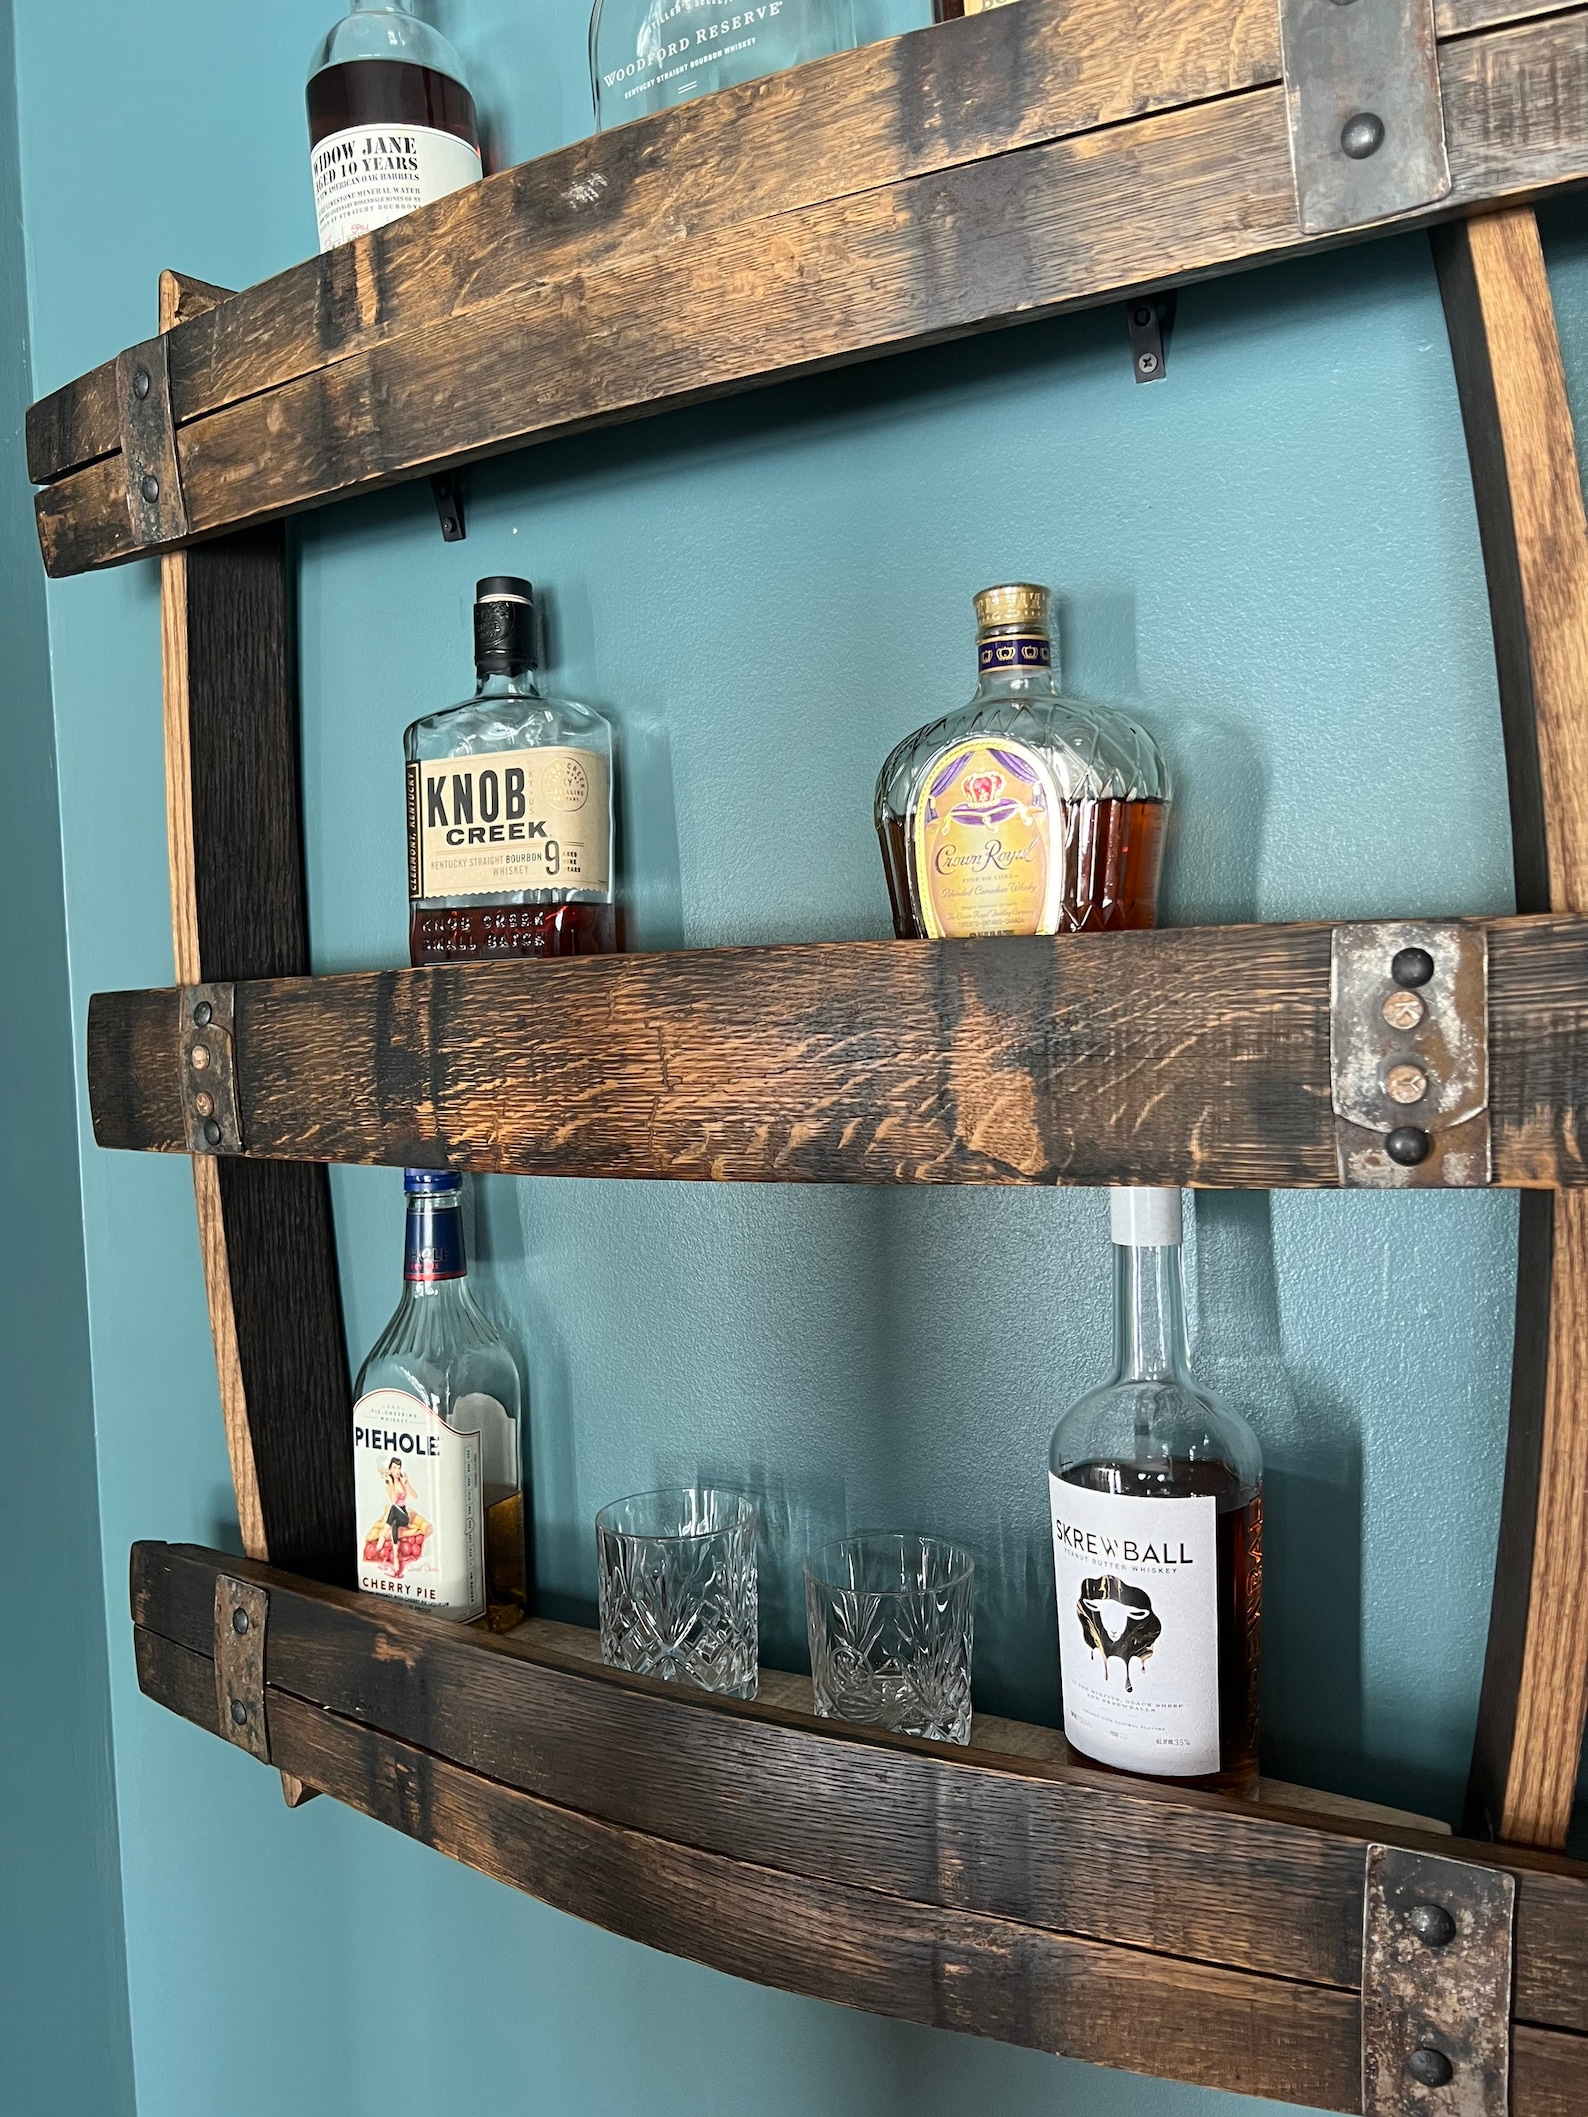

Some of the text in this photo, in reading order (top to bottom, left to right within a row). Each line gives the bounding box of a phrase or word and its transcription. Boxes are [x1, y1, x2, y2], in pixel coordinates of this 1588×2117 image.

[604, 38, 690, 88] WOODFORD
[624, 37, 756, 100] KENTUCKY STRAIGHT BOURBON WHISKEY
[362, 137, 417, 156] JANE
[341, 161, 358, 178] 10
[362, 157, 418, 172] YEARS
[329, 176, 360, 193] AMERICAN
[361, 174, 378, 182] OAK
[381, 173, 419, 181] BARRELS
[358, 188, 392, 199] MINERAL
[340, 206, 374, 219] STRAIGHT
[408, 773, 416, 828] KENTUCKY
[428, 768, 526, 827] KNOB
[446, 821, 547, 846] CREEK
[431, 853, 542, 870] KENTUCKY STRAIGHT BOURBON
[545, 841, 559, 875] 9
[935, 839, 1036, 875] Crown Royal
[493, 865, 529, 876] WHISKEY
[941, 886, 974, 898] Blended
[356, 1427, 440, 1456] PIEHOLE
[1057, 1519, 1193, 1564] SKREWBALL
[1064, 1548, 1177, 1574] PEANUT BUTTER WHISKEY
[363, 1577, 436, 1600] CHERRY PIE
